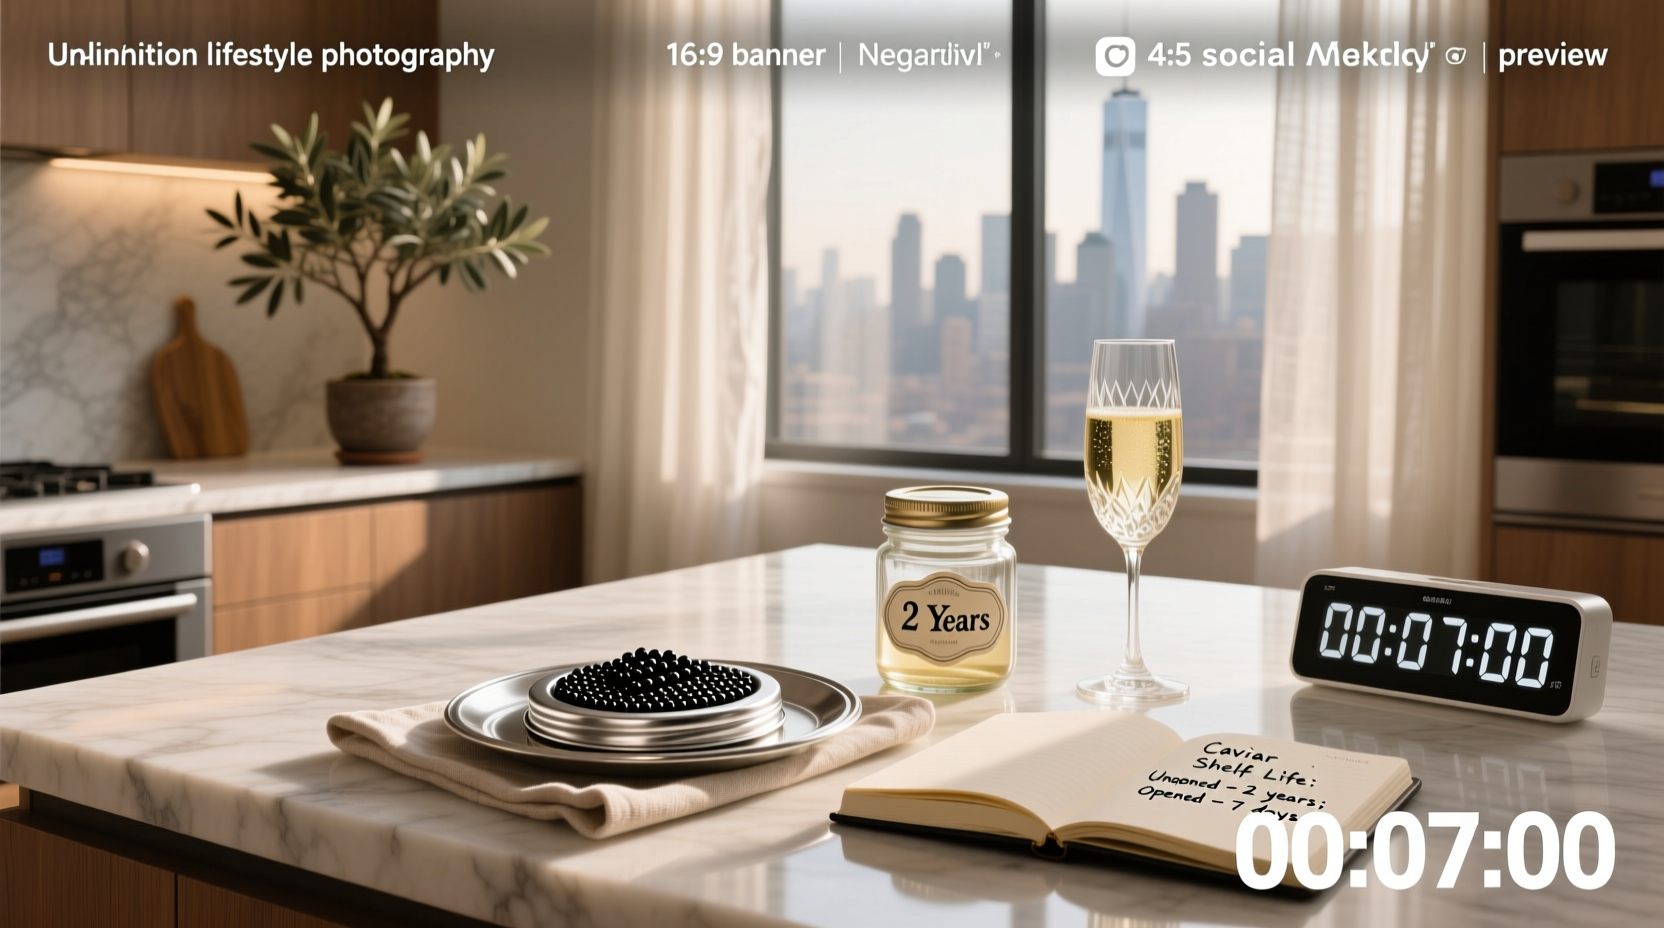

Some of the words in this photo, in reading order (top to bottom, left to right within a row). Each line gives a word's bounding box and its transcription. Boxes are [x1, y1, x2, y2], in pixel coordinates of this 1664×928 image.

[901, 600, 919, 632] 2
[926, 604, 990, 632] Years
[1319, 602, 1554, 689] 00:07:00
[1203, 741, 1279, 763] Caviar
[1192, 757, 1254, 779] Shelf
[1138, 785, 1207, 803] Opened
[1232, 800, 1245, 811] 7
[1242, 785, 1257, 796] 2
